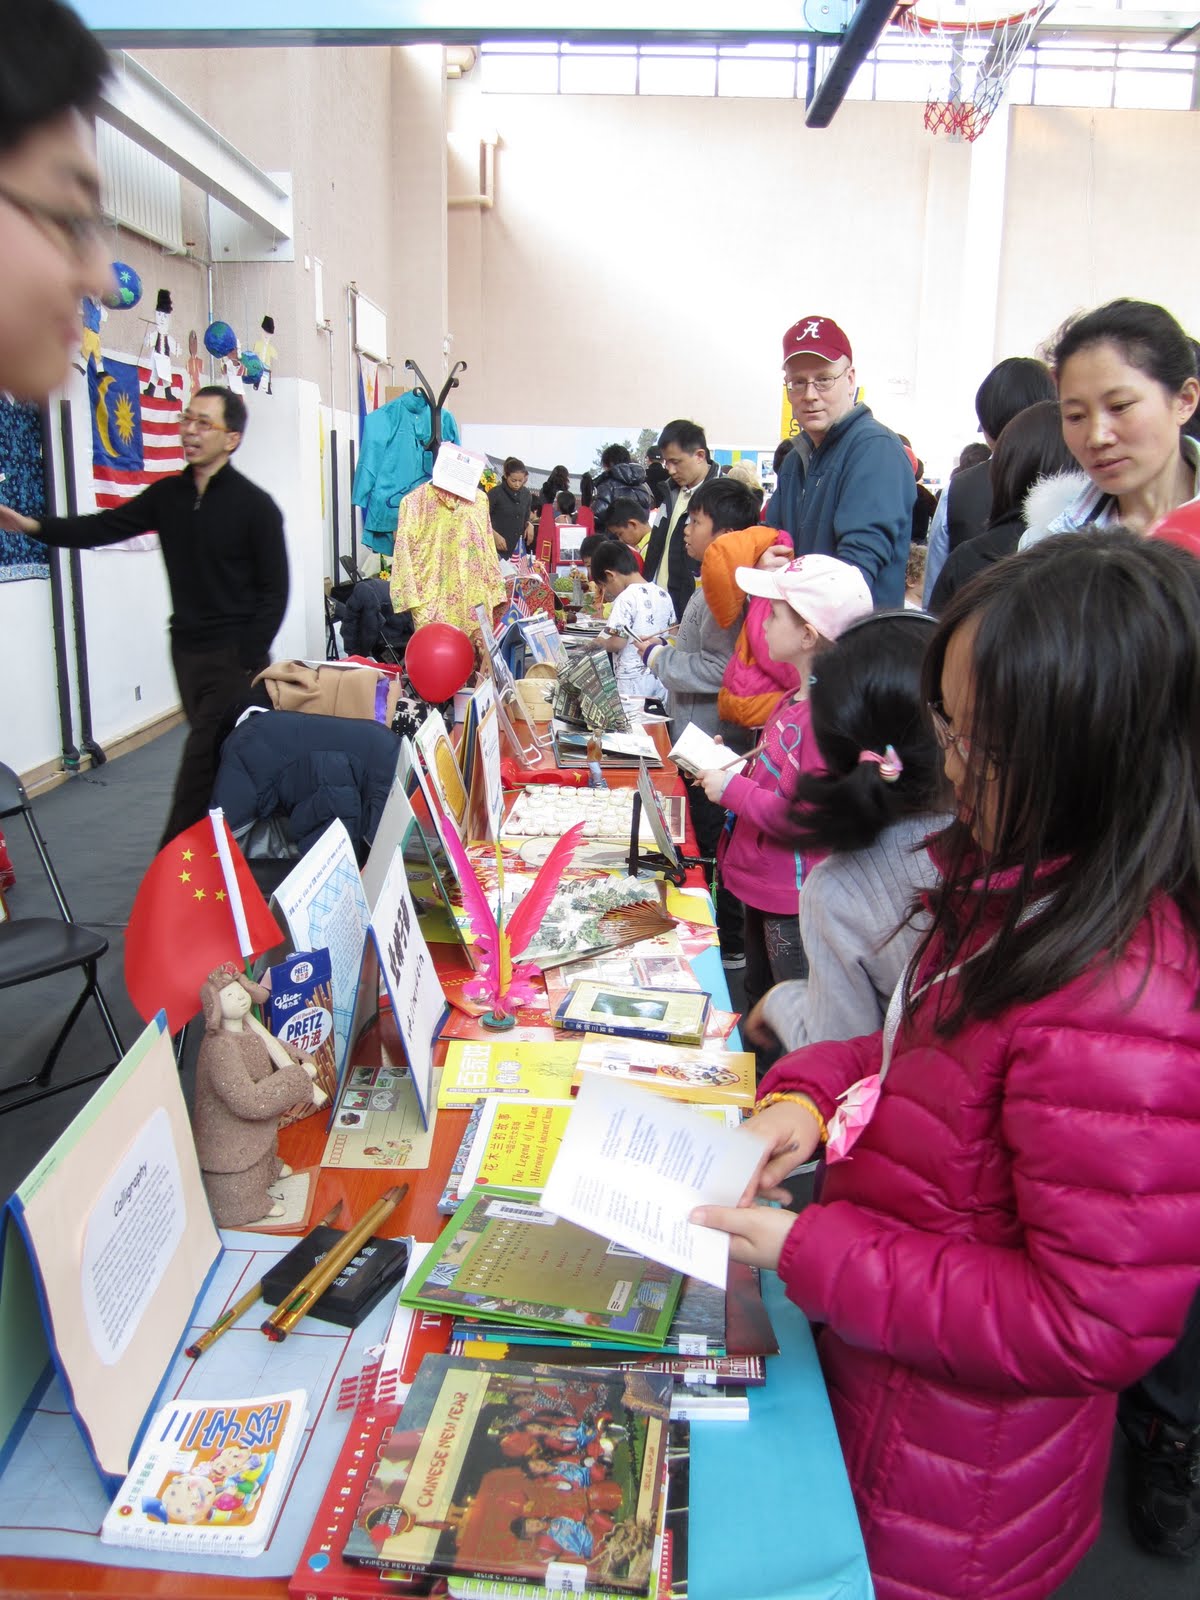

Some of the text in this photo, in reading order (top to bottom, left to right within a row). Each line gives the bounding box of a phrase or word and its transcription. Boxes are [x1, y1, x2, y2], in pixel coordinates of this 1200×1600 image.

[796, 321, 820, 341] A
[295, 965, 309, 975] PRETZ
[274, 993, 302, 1009] Glico
[287, 1011, 323, 1041] PRETZ
[542, 1107, 554, 1123] China
[484, 1113, 511, 1171] 花木兰的故事
[512, 1107, 539, 1182] The Legend of Mu Lan
[540, 1123, 550, 1146] Ancient
[530, 1152, 544, 1178] Heroine
[114, 1160, 147, 1217] Calligraphy
[470, 1222, 515, 1286] TRUE BOOK
[461, 1269, 475, 1285] Look
[493, 1274, 504, 1283] by
[571, 1340, 592, 1348] China
[159, 1403, 285, 1448] 三字经
[417, 1392, 469, 1507] CHINESE NEW YEAR
[360, 1558, 426, 1572] CHINESE NEW YEAR
[661, 1532, 669, 1580] HOLIDAYS
[474, 1572, 494, 1581] LESLIE
